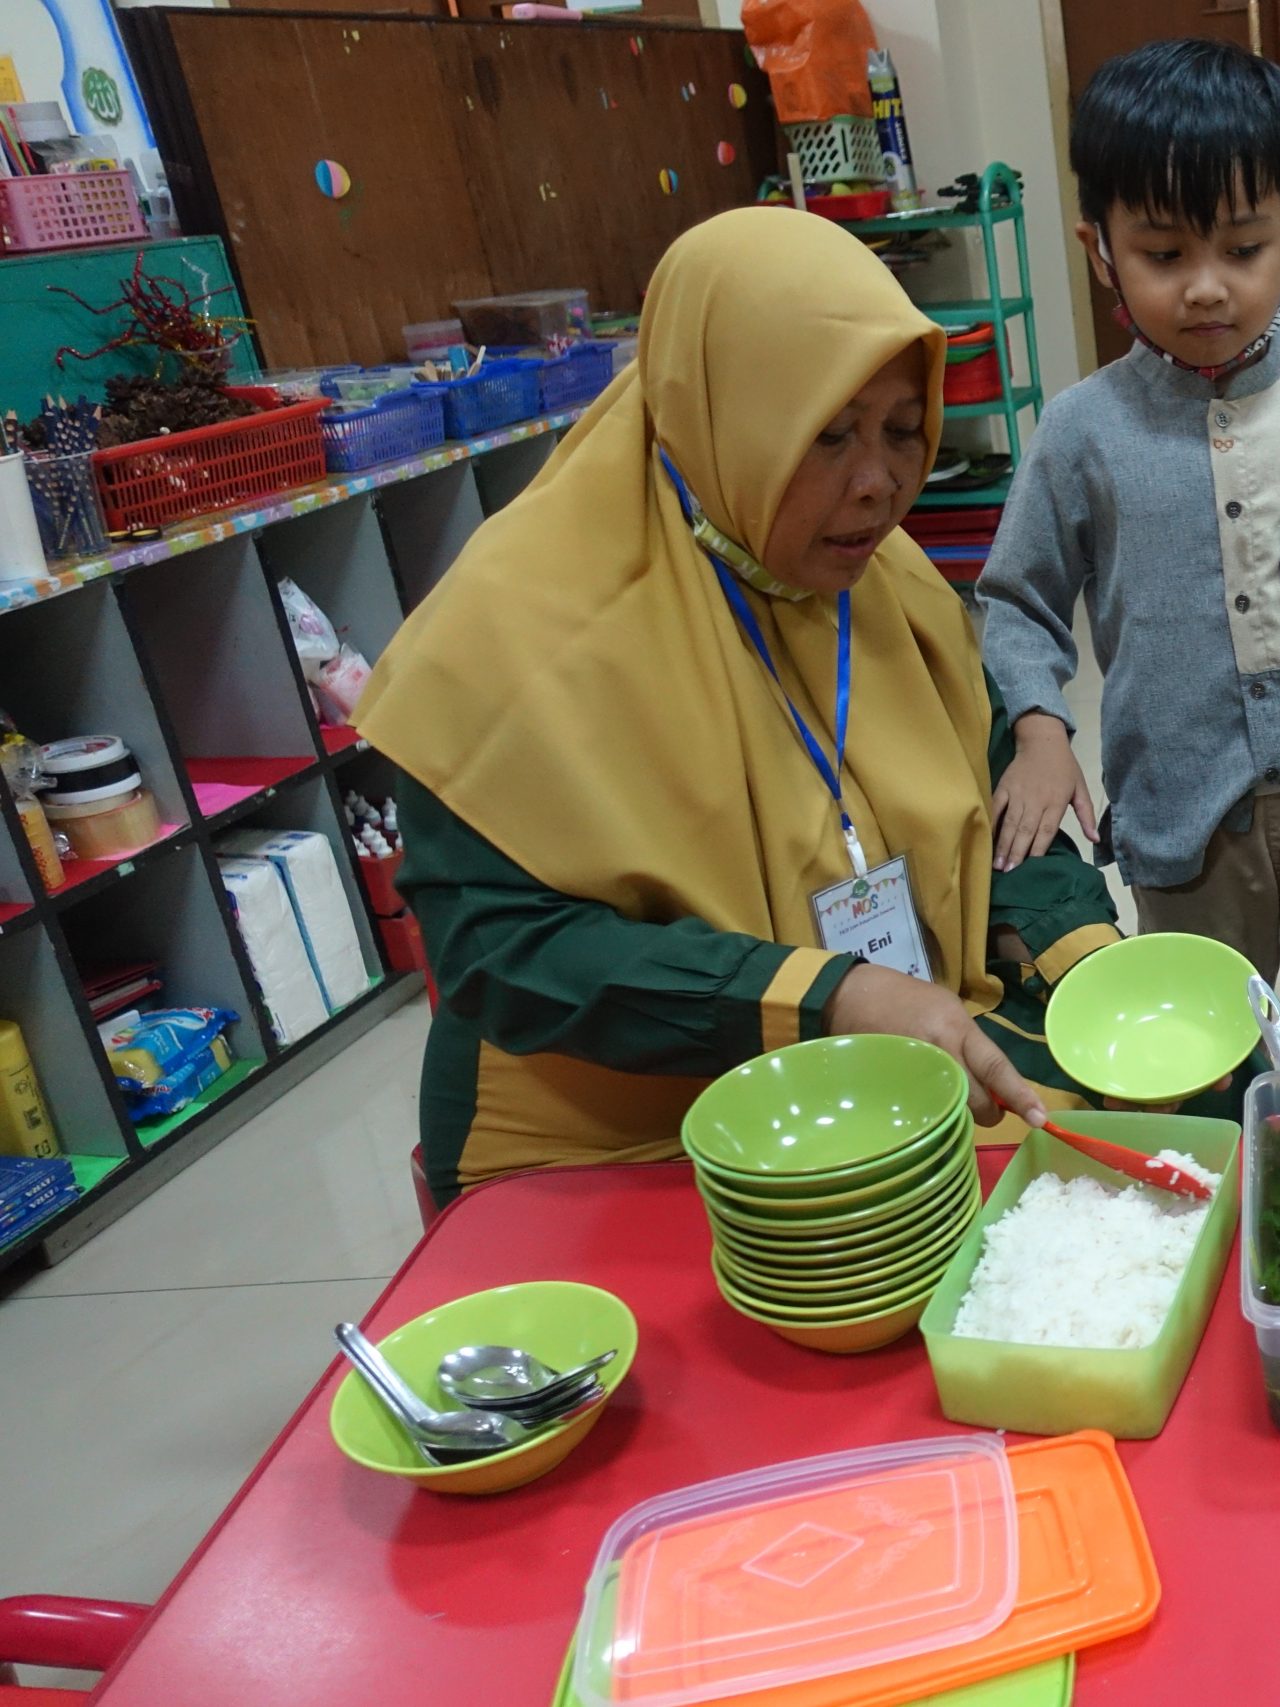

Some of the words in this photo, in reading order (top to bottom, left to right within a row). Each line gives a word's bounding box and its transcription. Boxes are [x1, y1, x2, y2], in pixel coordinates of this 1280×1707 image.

[873, 97, 902, 119] HIT
[852, 893, 879, 919] MOS
[867, 931, 893, 955] Eni
